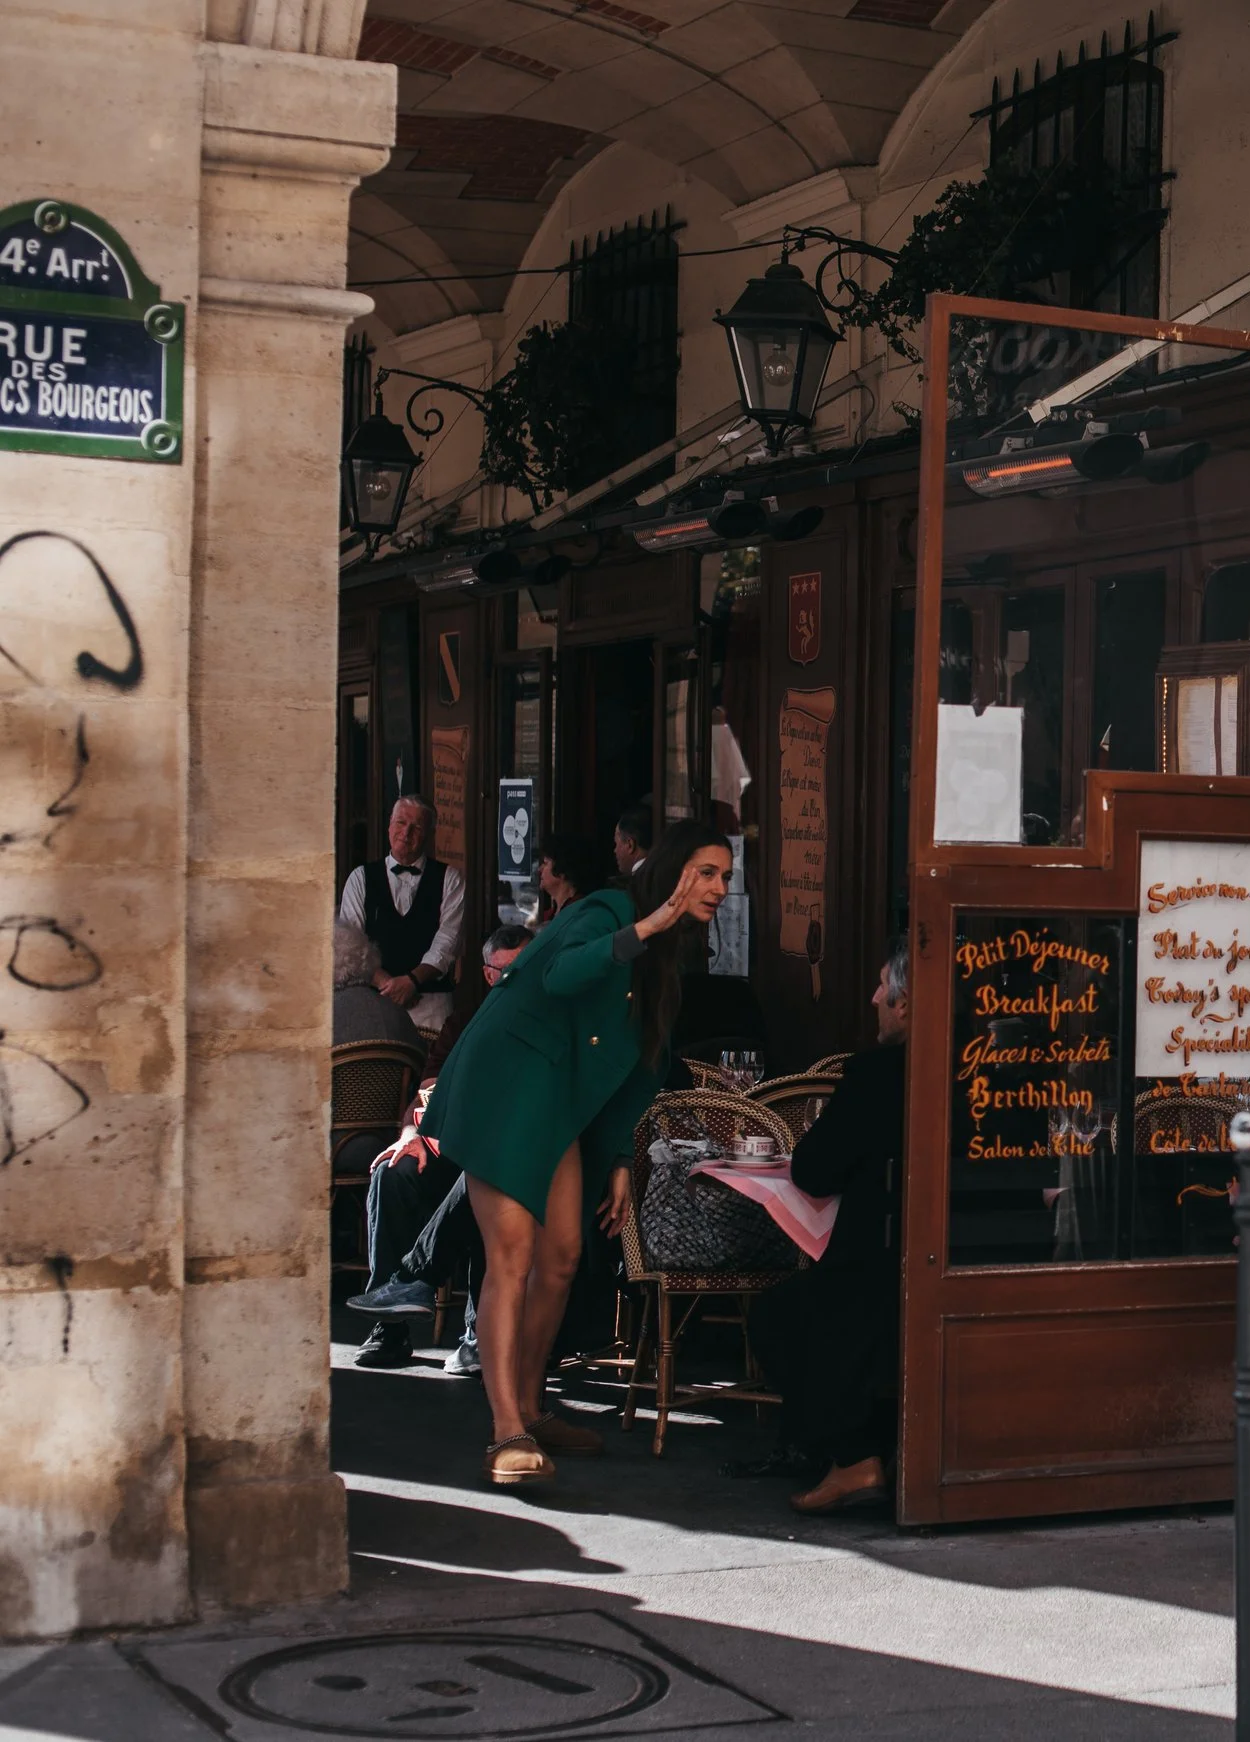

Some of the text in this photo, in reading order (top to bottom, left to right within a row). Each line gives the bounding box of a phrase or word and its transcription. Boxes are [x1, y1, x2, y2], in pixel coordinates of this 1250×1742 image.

[0, 323, 87, 365] RUE
[12, 360, 67, 382] DES
[38, 381, 153, 424] BOURGEOIS
[1147, 877, 1217, 914] Service
[955, 927, 1111, 979] Petit Déjeuner
[1153, 928, 1199, 960] Plat
[1202, 939, 1225, 959] du
[975, 983, 1100, 1032] Breakfast
[1145, 977, 1220, 1018] Today's
[957, 1031, 1112, 1081] Glaces & Sorbets
[966, 1075, 1094, 1119] Berthillon
[1152, 1079, 1173, 1098] de
[968, 1134, 1026, 1160] Salon
[1029, 1140, 1047, 1158] de
[1197, 1133, 1217, 1153] de
